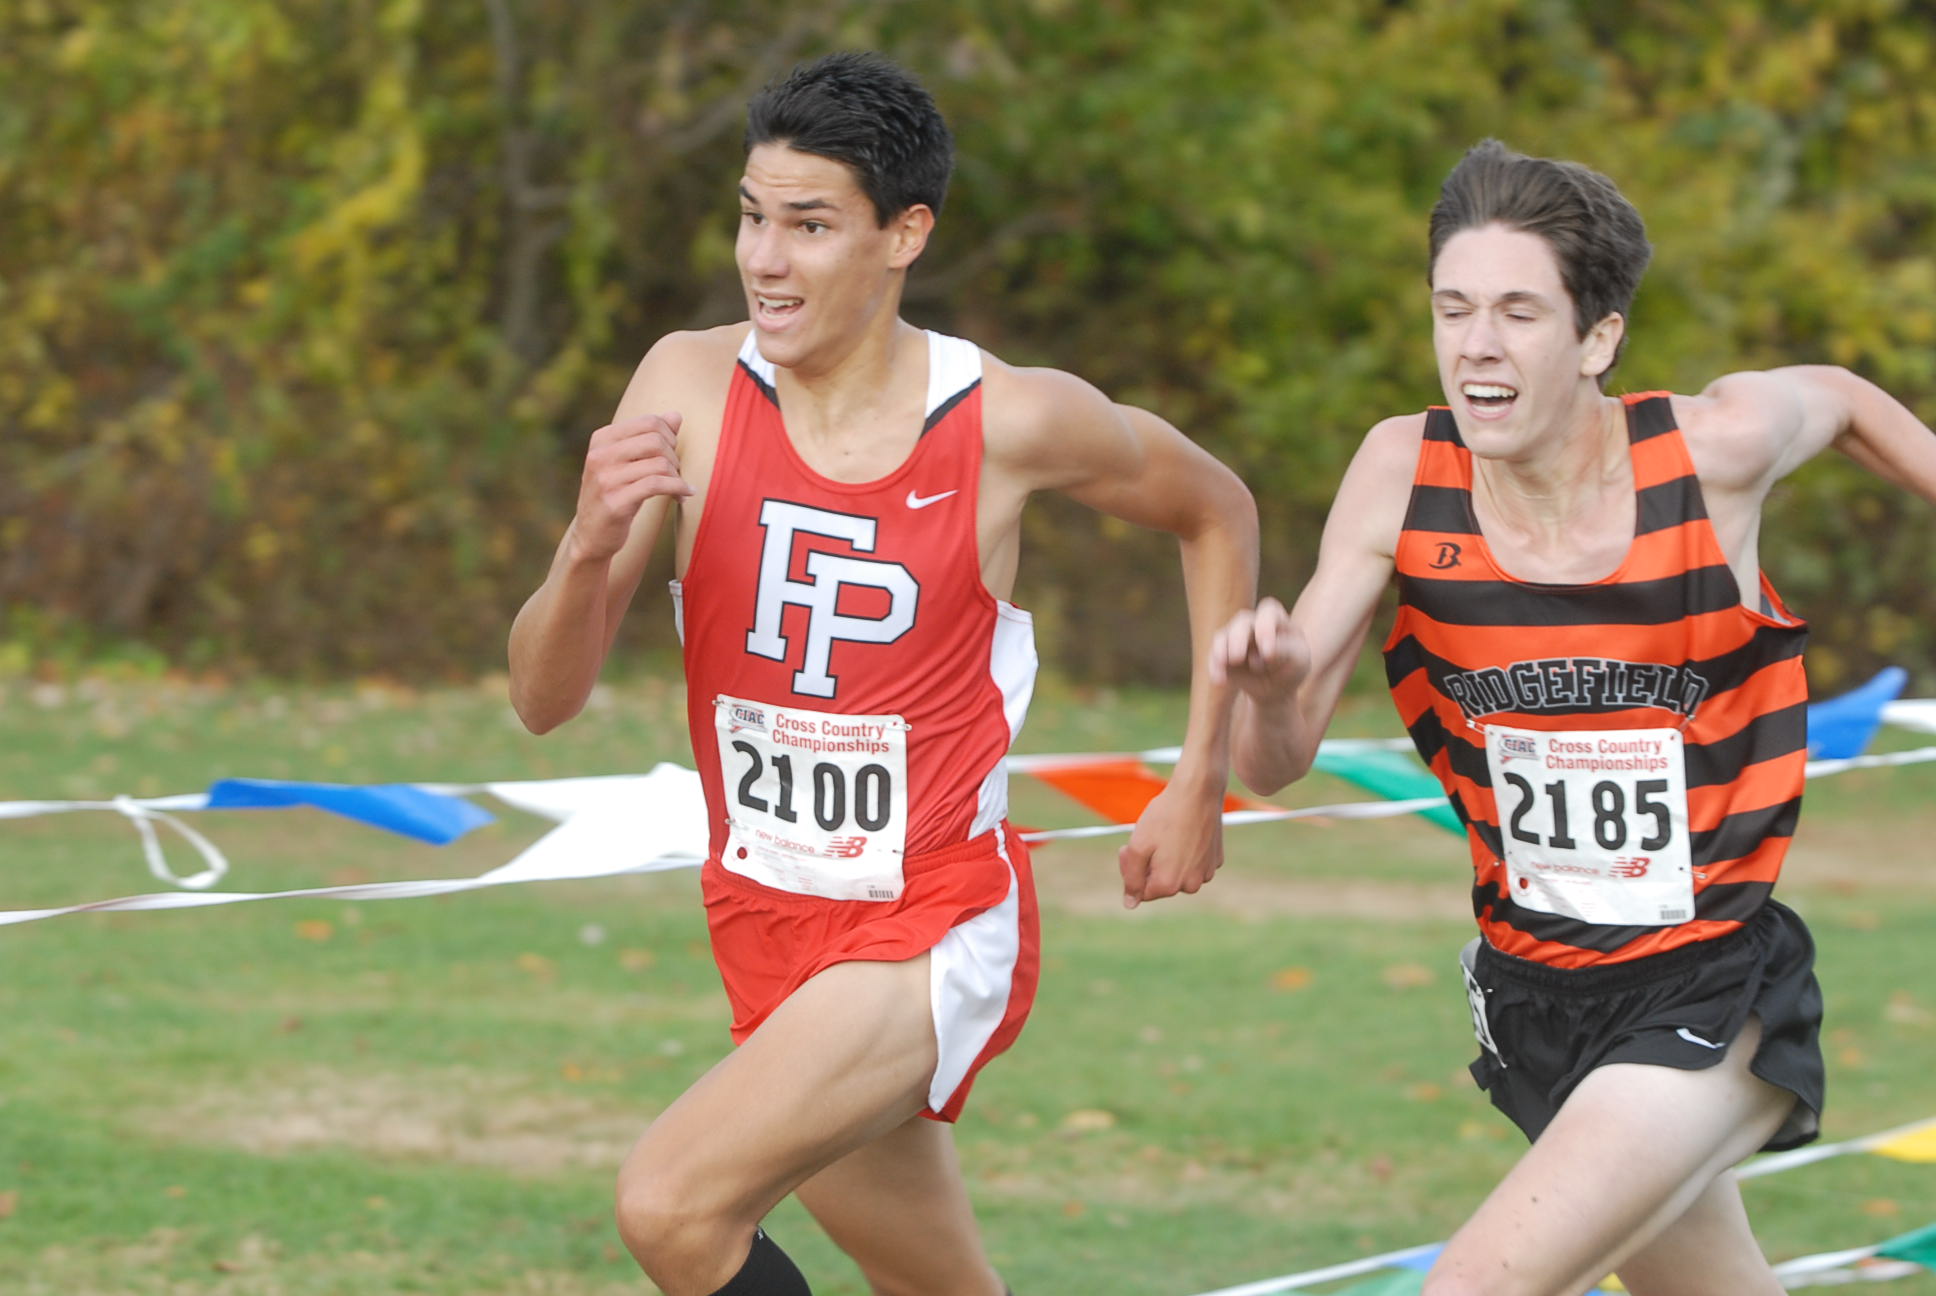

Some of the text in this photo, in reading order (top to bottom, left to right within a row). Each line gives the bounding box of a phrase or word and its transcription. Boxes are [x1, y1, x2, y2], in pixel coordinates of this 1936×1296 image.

[1444, 657, 1710, 718] RIDGEFIELD
[776, 713, 885, 740] Cross Country
[772, 729, 890, 755] Championships
[1549, 738, 1662, 755] Cross Country
[1546, 755, 1668, 773] Championships
[731, 740, 891, 832] 2100
[1503, 771, 1672, 851] 2185
[755, 829, 815, 854] new balance
